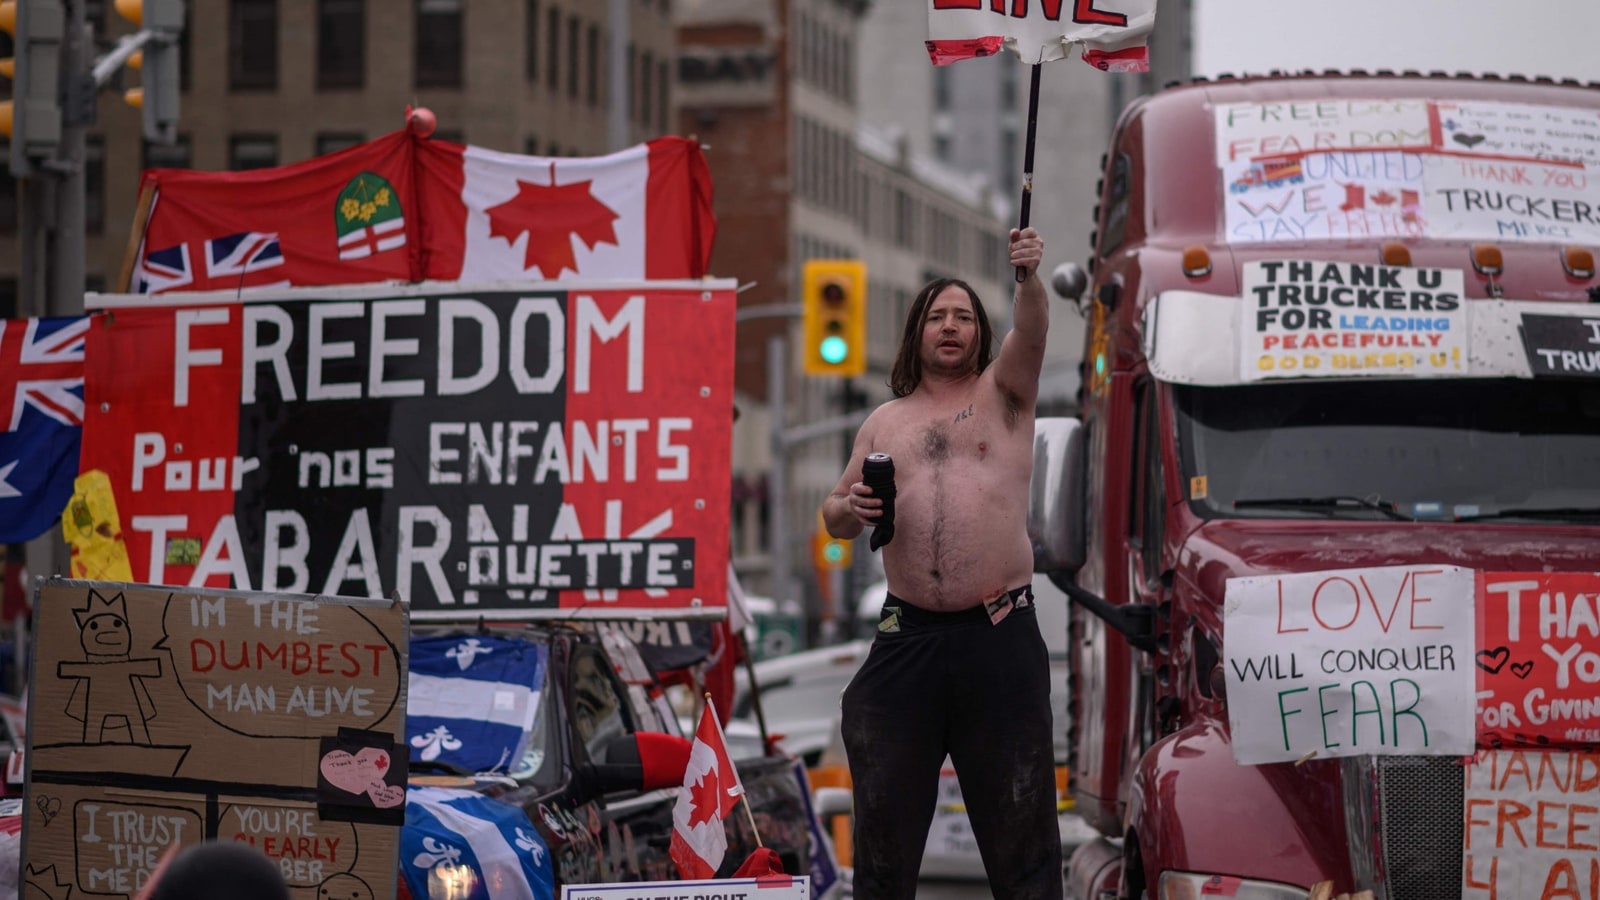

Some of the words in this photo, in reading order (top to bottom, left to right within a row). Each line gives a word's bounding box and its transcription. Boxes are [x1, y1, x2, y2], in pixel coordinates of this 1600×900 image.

[1305, 150, 1423, 182] UNITED
[1456, 161, 1533, 186] THANK
[1542, 167, 1587, 191] YOU
[1237, 184, 1329, 218] WE
[1232, 213, 1318, 240] STAY
[1260, 261, 1402, 288] THANK
[1417, 269, 1442, 288] U
[1252, 285, 1460, 311] TRUCKERS
[1256, 308, 1333, 332] FOR
[1339, 315, 1451, 331] LEADING
[173, 295, 646, 407] FREEDOM
[1263, 333, 1443, 351] PEACEFULLY
[1257, 354, 1321, 370] GOD
[1331, 353, 1415, 369] BLESS
[131, 432, 261, 492] Pour
[298, 447, 396, 489] nos
[428, 417, 693, 486] ENFANTS
[246, 599, 321, 635] THE
[1276, 569, 1445, 634] LOVE
[1486, 580, 1600, 643] THA
[190, 637, 388, 678] DUMBEST
[1230, 652, 1304, 682] WILL
[1320, 644, 1456, 674] CONQUER
[207, 682, 276, 714] MAN
[286, 684, 376, 717] ALIVE
[1277, 678, 1429, 751] FEAR
[1464, 750, 1600, 793] MAND
[81, 804, 102, 842] I
[106, 810, 187, 846] TRUST
[233, 805, 318, 838] YOU'RE
[107, 843, 159, 870] THE
[279, 857, 324, 883] BER
[87, 867, 151, 893] MED
[1465, 854, 1499, 900] 4
